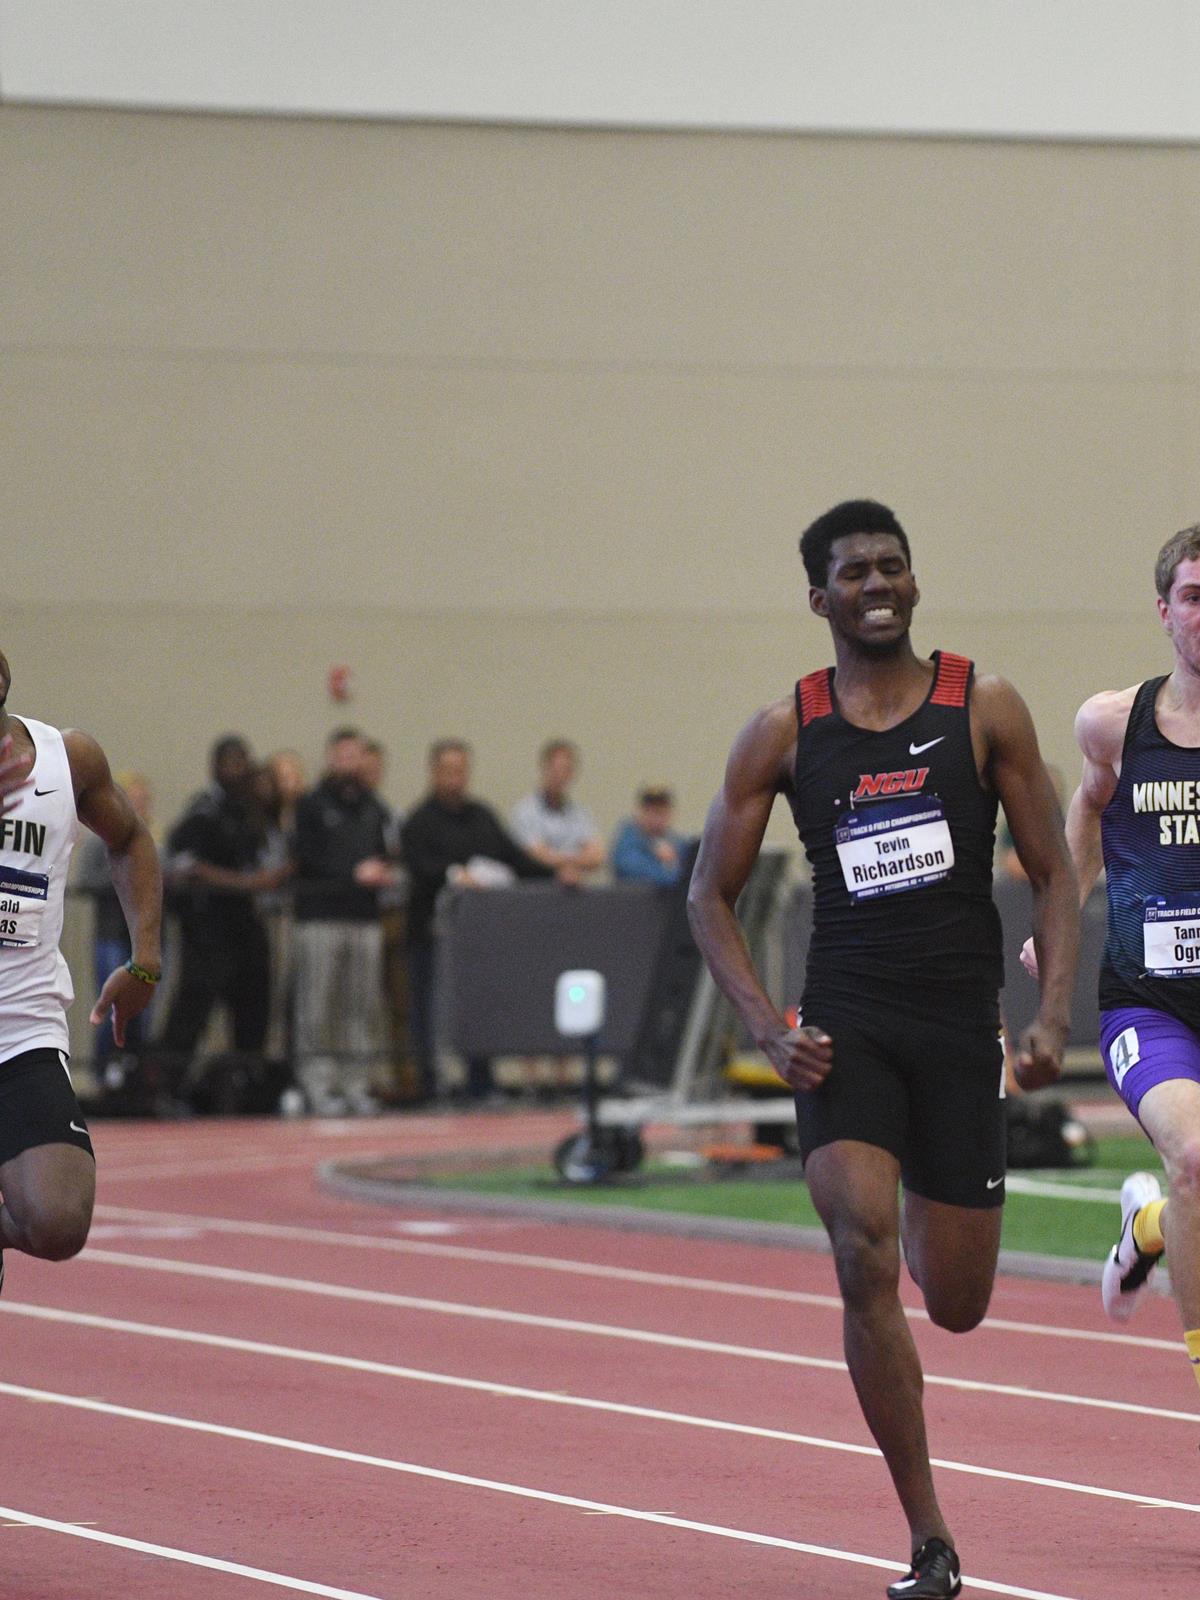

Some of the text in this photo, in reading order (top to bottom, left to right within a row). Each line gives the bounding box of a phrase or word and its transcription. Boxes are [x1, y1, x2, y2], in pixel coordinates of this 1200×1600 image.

[854, 767, 930, 796] NGU
[873, 820, 890, 831] FIELD
[874, 837, 911, 855] Tevin
[852, 849, 945, 884] Richardson
[1157, 908, 1174, 917] TRACK
[1180, 907, 1196, 916] FIELD
[1115, 1033, 1133, 1074] 4
